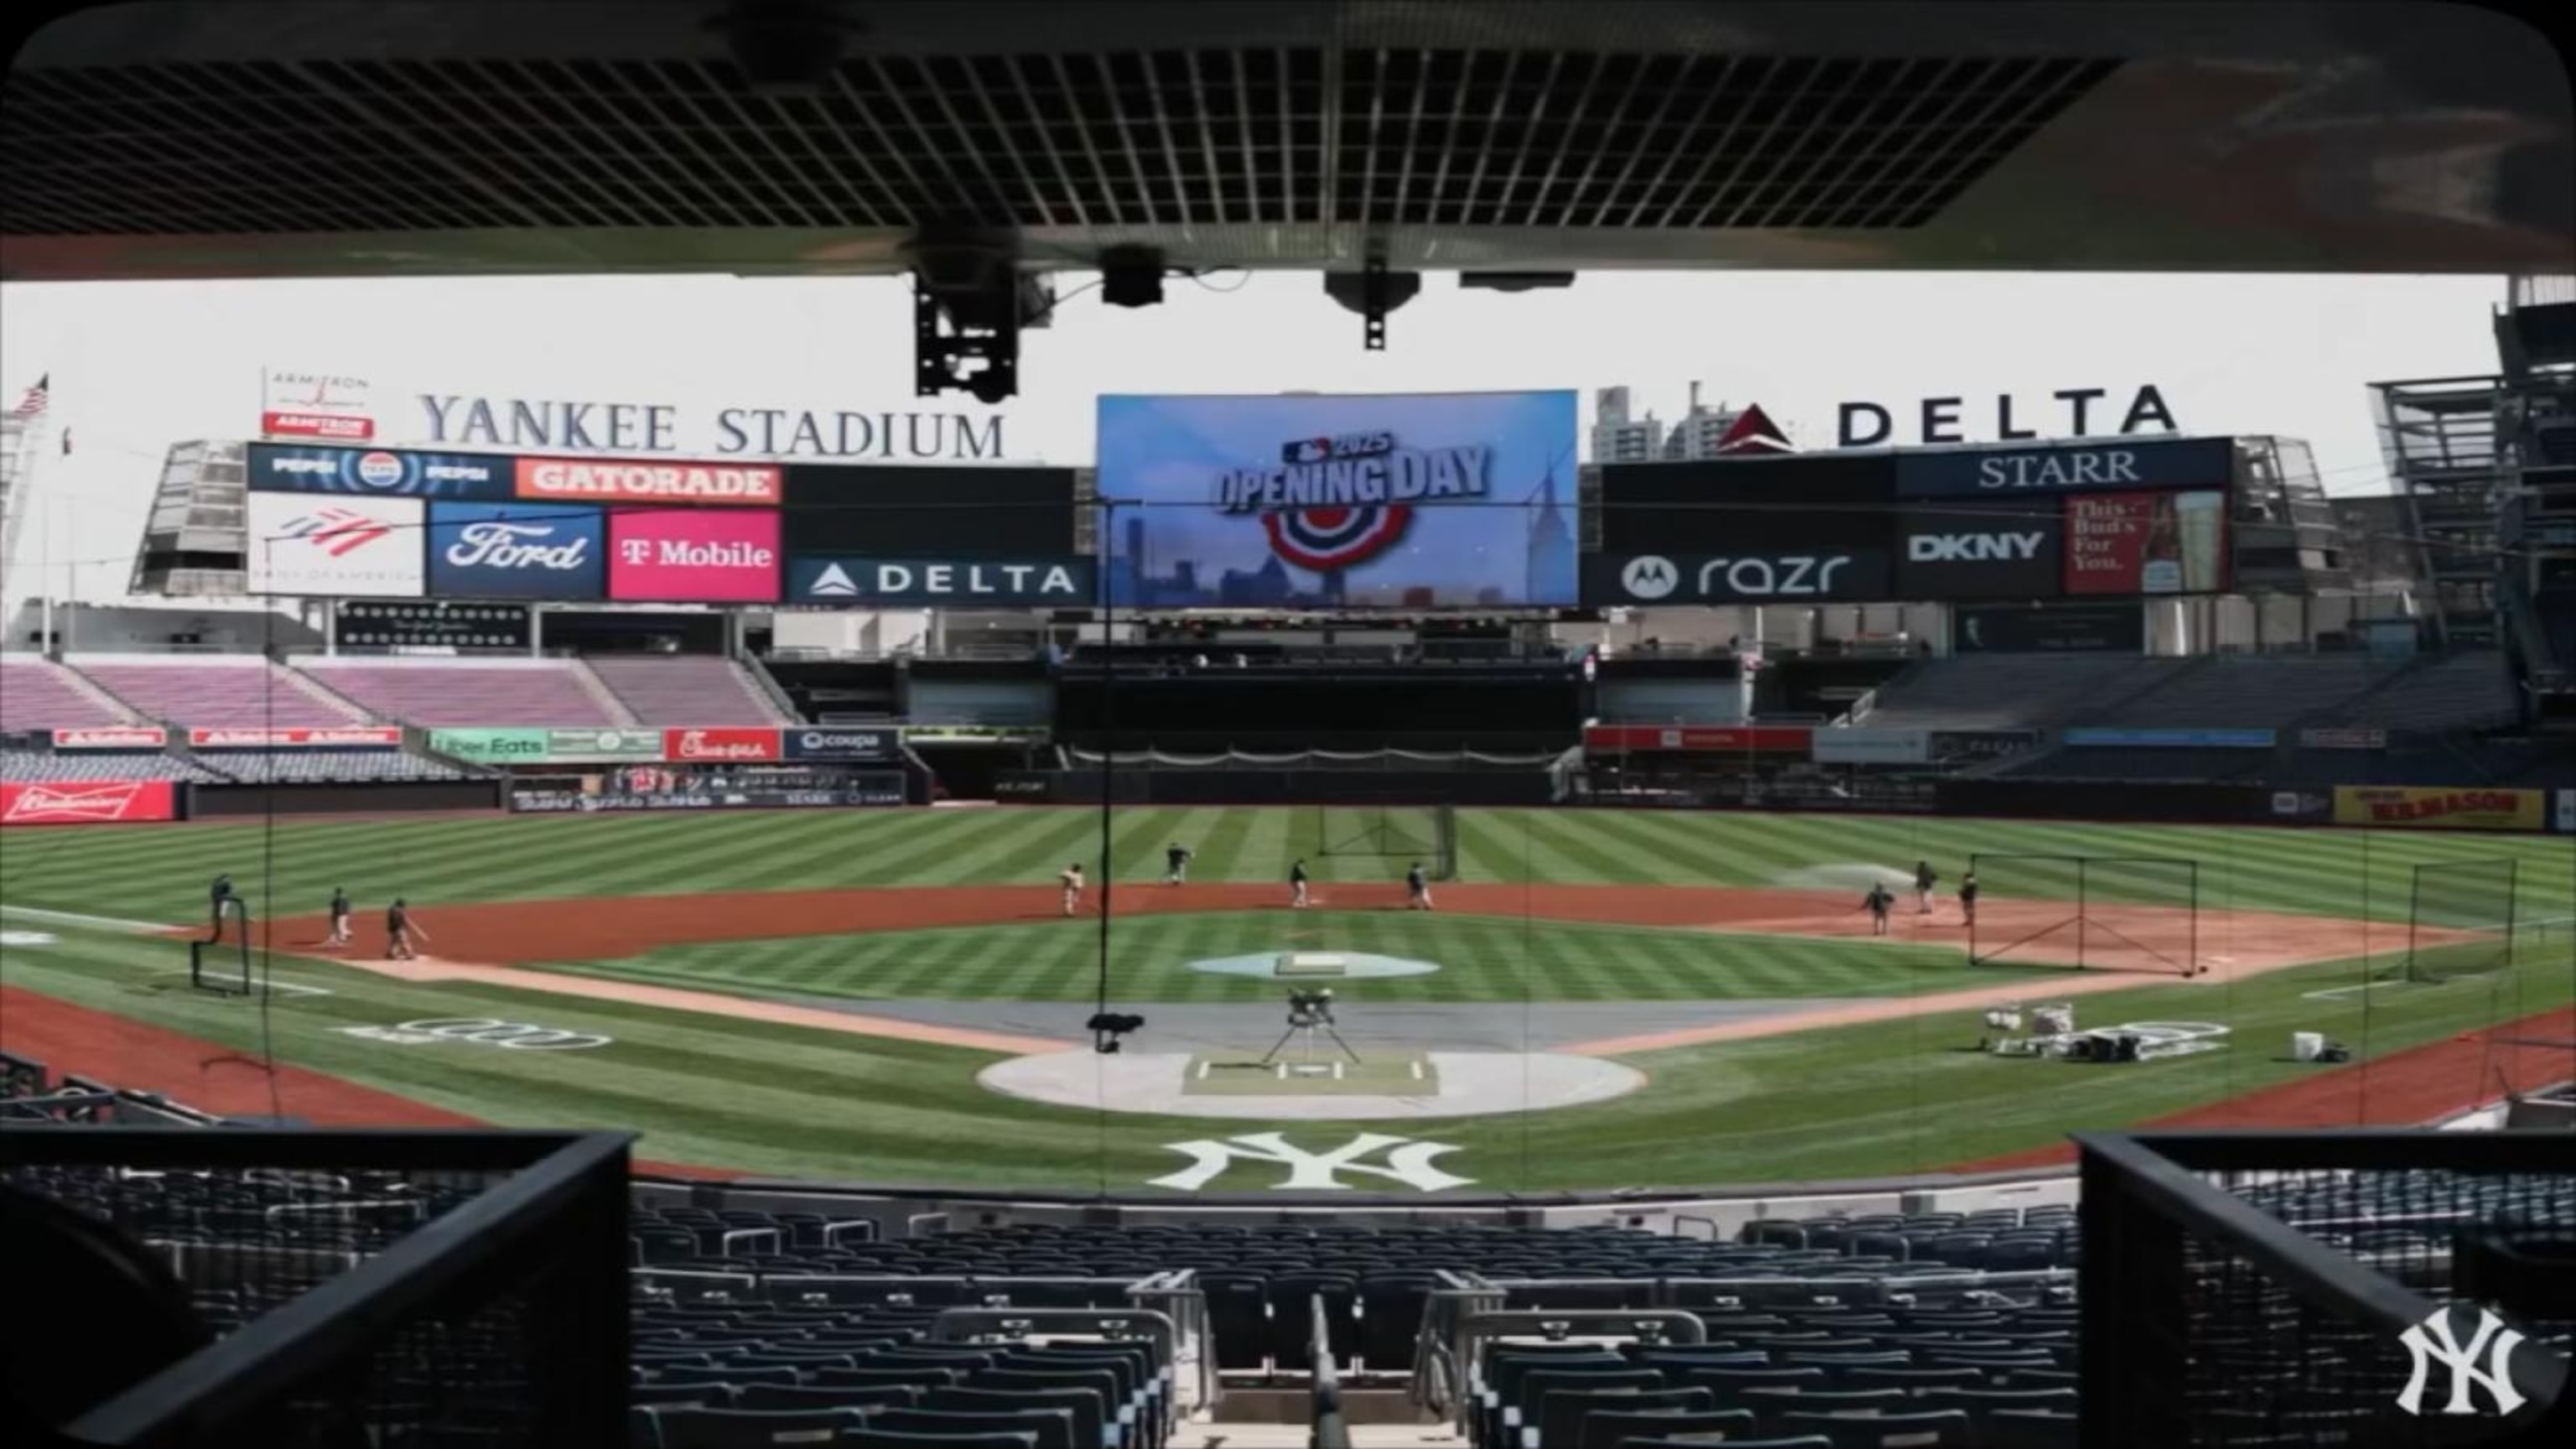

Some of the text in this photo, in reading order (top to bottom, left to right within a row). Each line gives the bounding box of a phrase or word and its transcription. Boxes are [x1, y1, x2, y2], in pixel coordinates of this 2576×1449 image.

[418, 394, 1005, 460] YANKEE STADIUM
[1839, 384, 2177, 447] DELTA
[1336, 432, 1392, 454] 2025
[273, 458, 337, 474] PEPSI
[425, 465, 489, 480] PEPSI
[1213, 445, 1491, 513] OPENING DAY
[1979, 451, 2141, 488] STARR
[532, 465, 771, 496] GATORADE
[2074, 500, 2125, 517] This
[447, 522, 589, 569] Ford
[660, 540, 773, 568] Mobile
[1909, 532, 2044, 561] DKNY
[2074, 537, 2111, 552] For
[879, 565, 1075, 593] DELTA
[1699, 557, 1851, 594] razr
[490, 738, 543, 755] Eats
[824, 734, 880, 749] coupa
